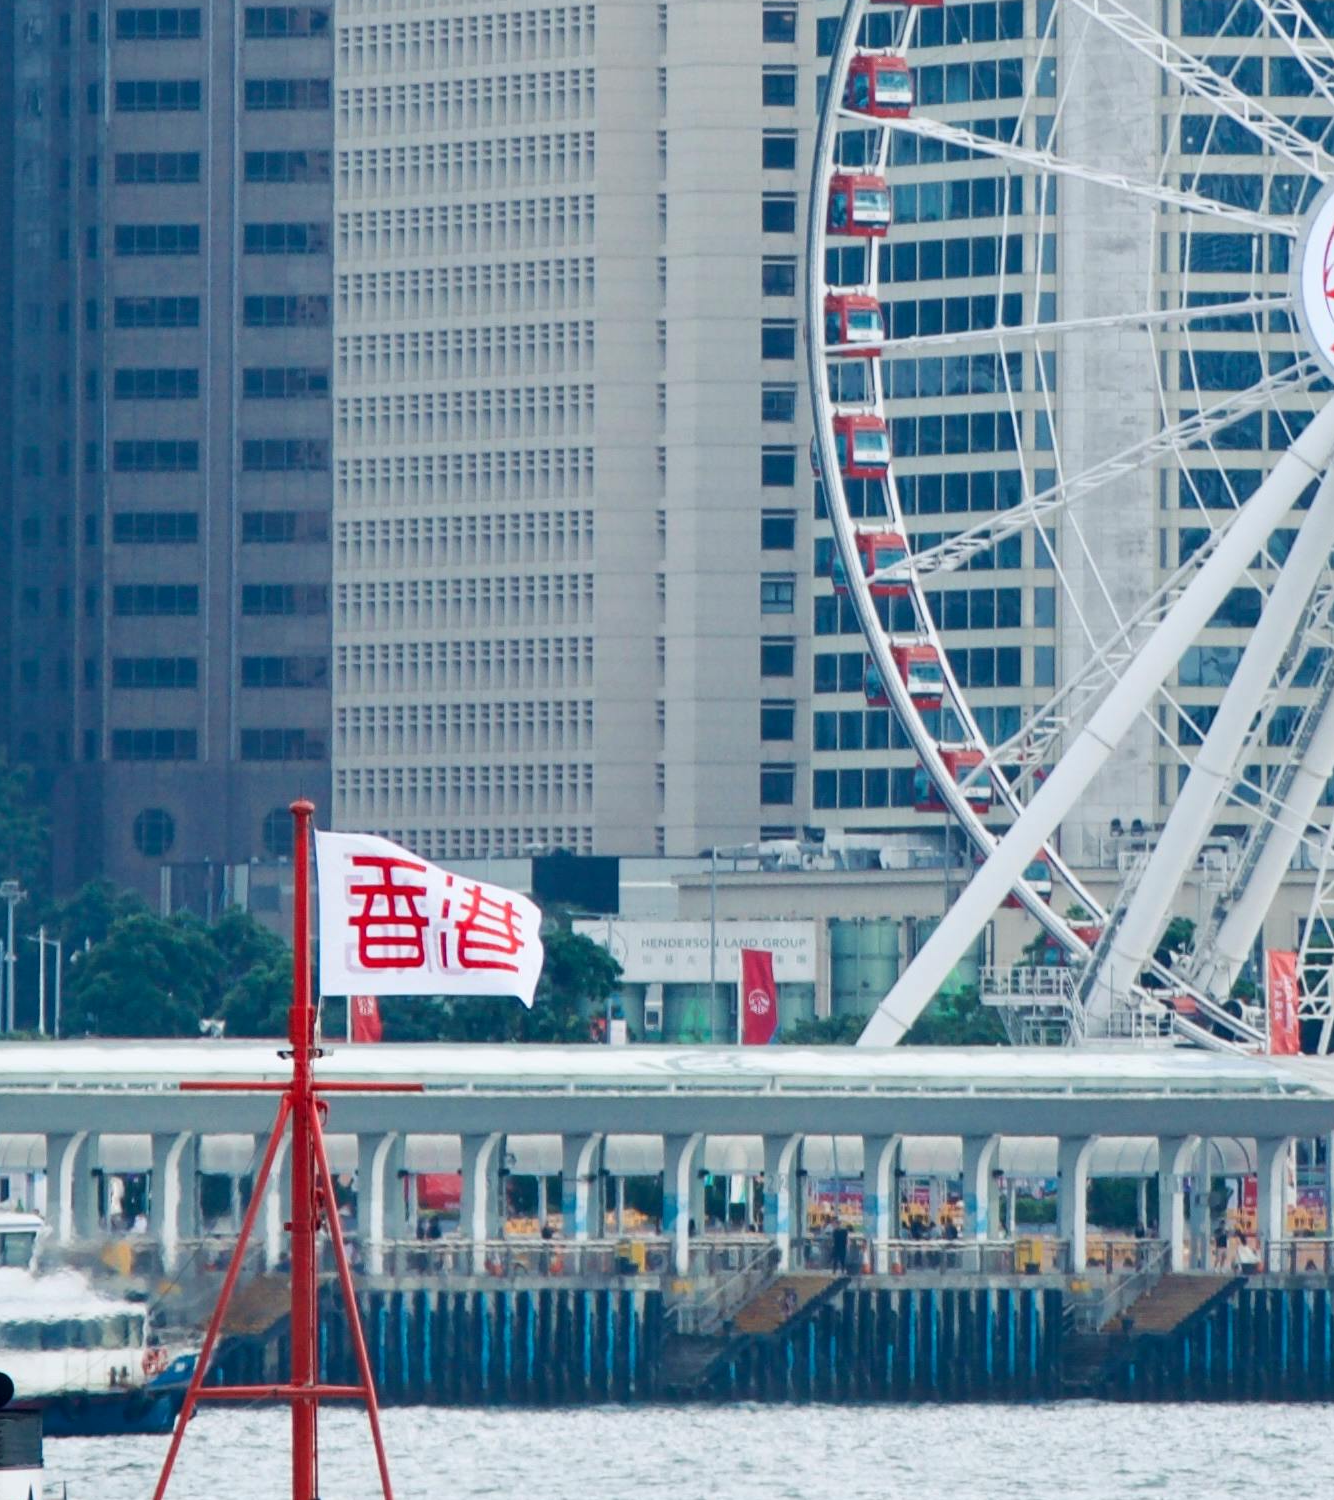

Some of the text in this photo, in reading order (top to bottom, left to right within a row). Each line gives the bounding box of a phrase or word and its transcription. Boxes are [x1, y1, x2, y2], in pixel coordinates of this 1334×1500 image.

[348, 855, 526, 974] 香港
[640, 937, 808, 949] HENDERSON LAND GROUP
